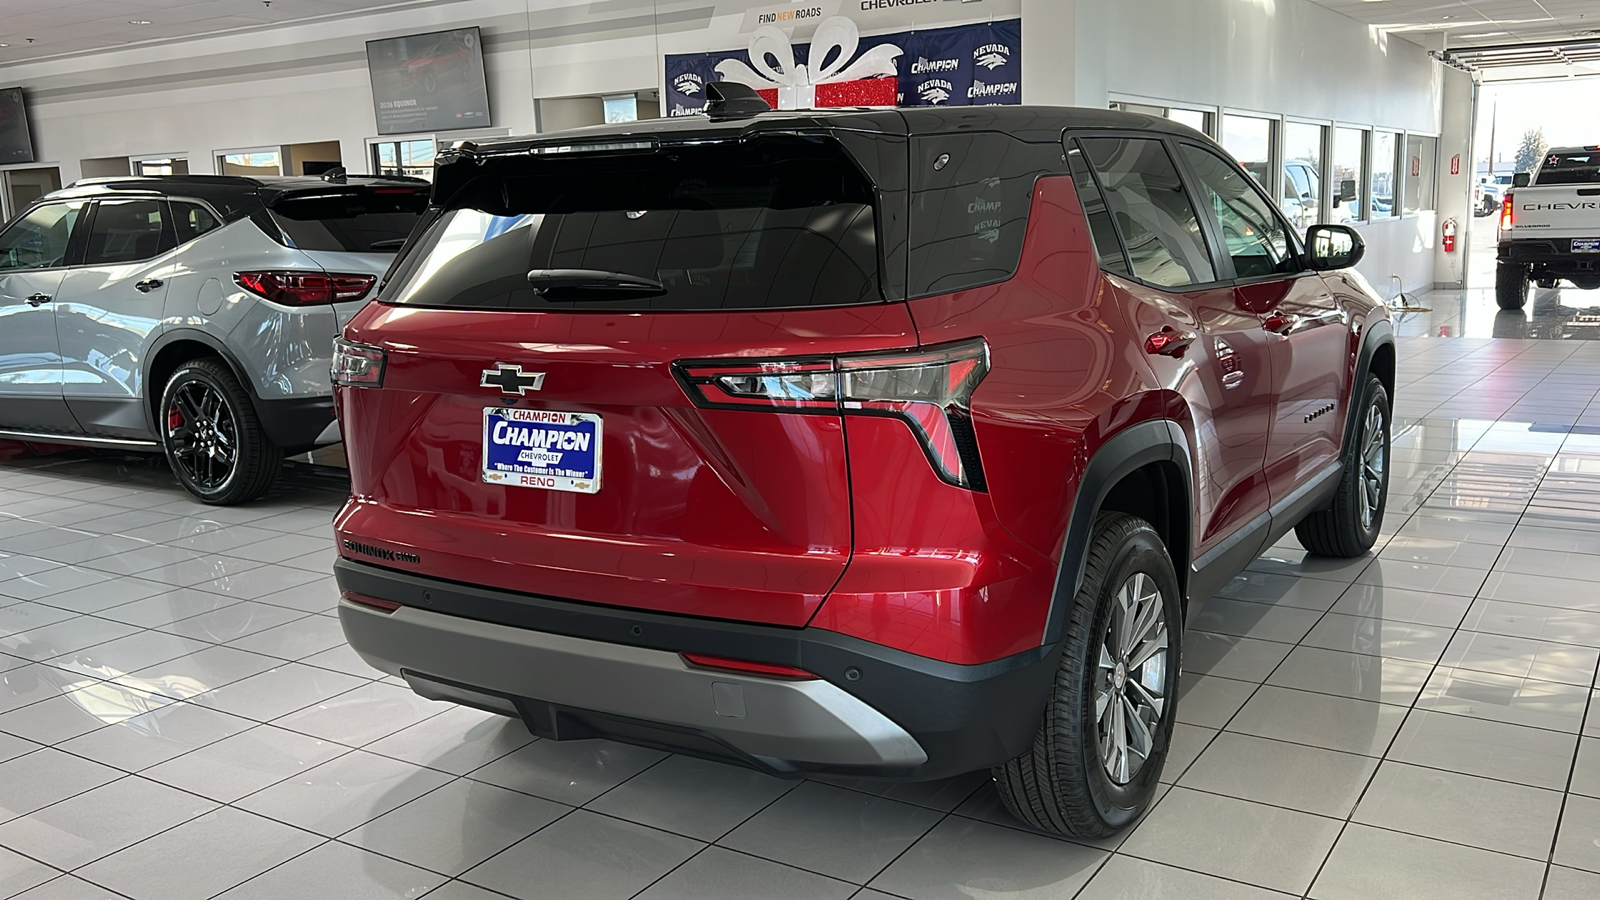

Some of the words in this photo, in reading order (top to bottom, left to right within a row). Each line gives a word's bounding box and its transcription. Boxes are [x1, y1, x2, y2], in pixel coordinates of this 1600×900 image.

[860, 0, 937, 11] CHEVR
[758, 13, 776, 24] FIND
[776, 10, 795, 21] NEW
[795, 7, 822, 19] ROADS
[973, 43, 1010, 59] NEVADA
[911, 58, 959, 74] CHAMPION
[673, 72, 703, 86] NEVADA
[917, 79, 953, 93] NEVADA
[967, 82, 1017, 98] CHAMPION
[393, 99, 417, 109] EQUINOX
[670, 106, 703, 117] CHAMPIO
[967, 201, 1001, 214] CHAMP
[974, 219, 1001, 233] NEVA
[513, 411, 566, 423] CHAMPION
[493, 421, 590, 451] CHAMPION
[520, 451, 559, 462] CHEVROLET
[513, 464, 523, 473] The
[523, 465, 548, 475] Customer
[548, 467, 554, 476] Is
[555, 468, 565, 476] The
[520, 475, 555, 488] RENO
[343, 540, 395, 562] EQUINOX
